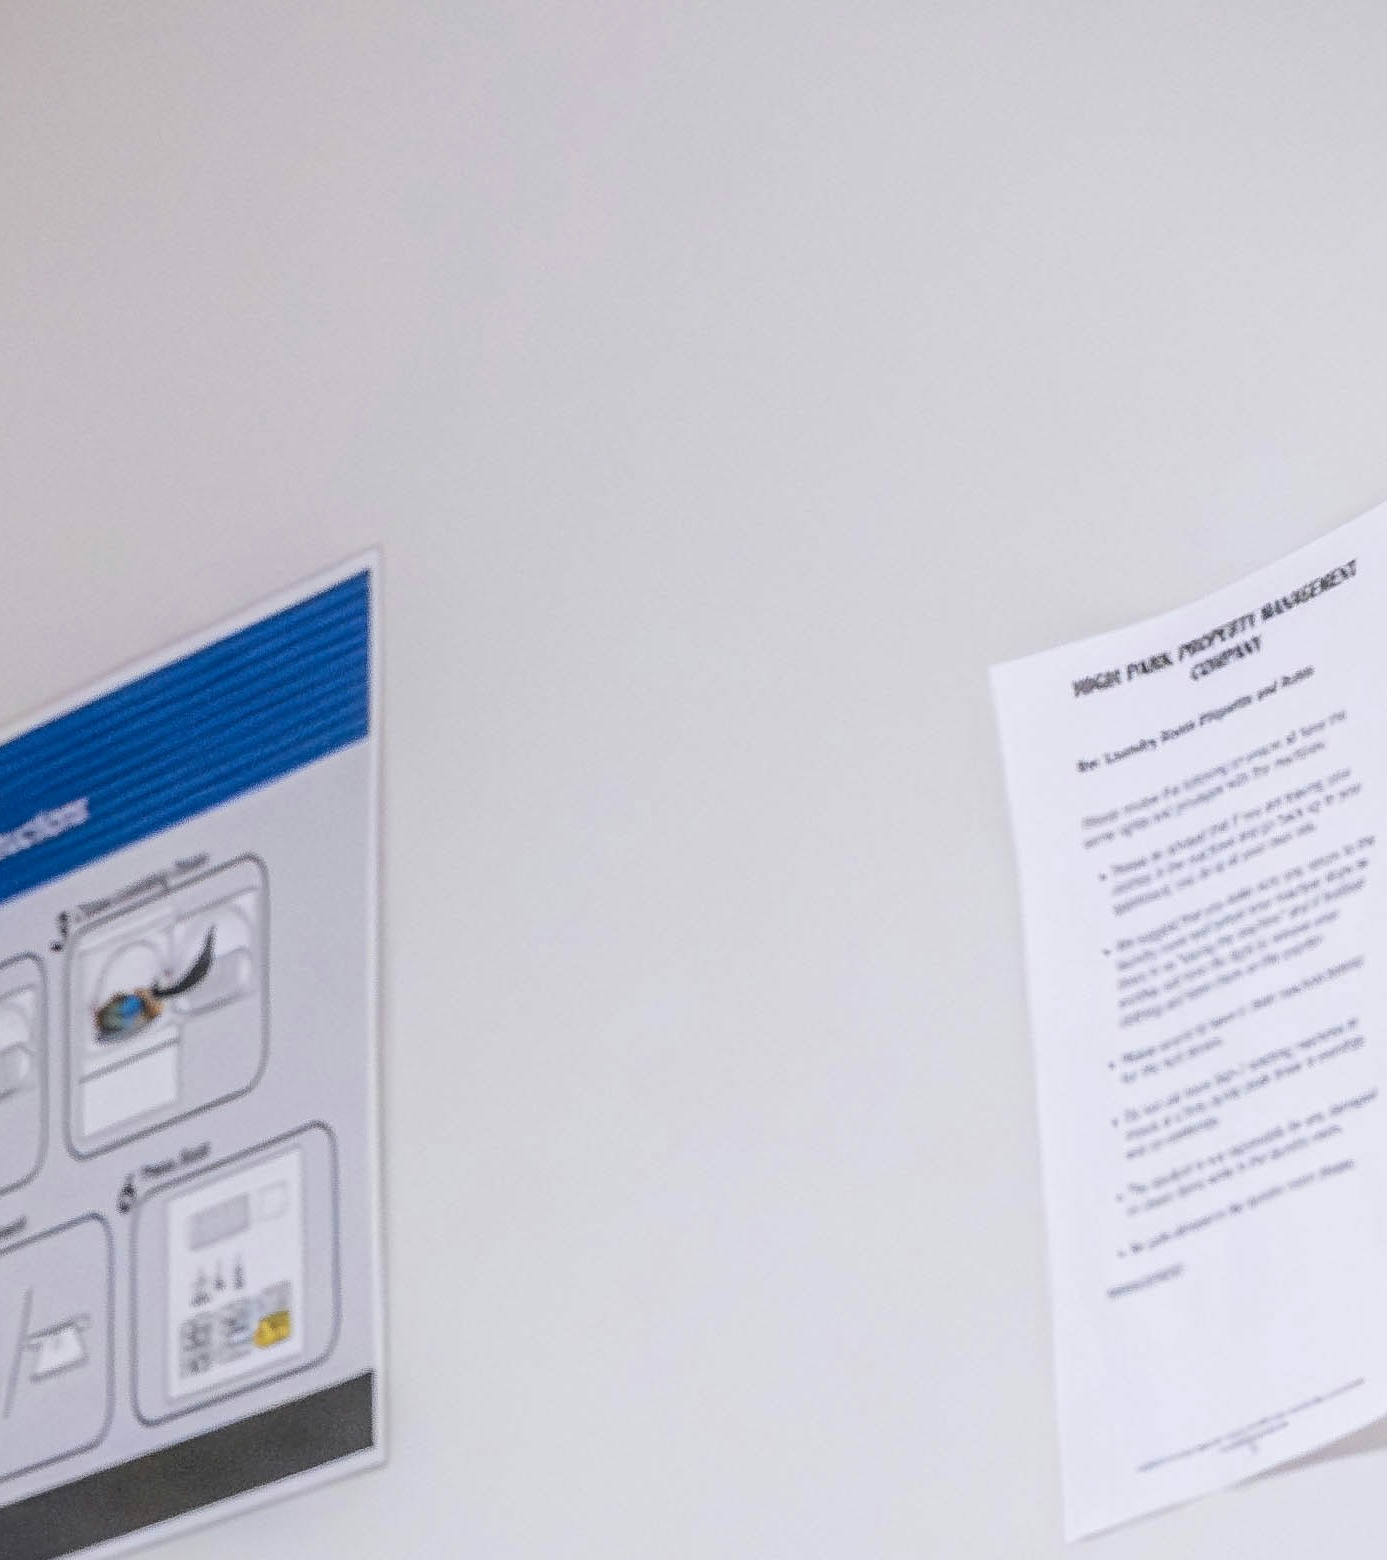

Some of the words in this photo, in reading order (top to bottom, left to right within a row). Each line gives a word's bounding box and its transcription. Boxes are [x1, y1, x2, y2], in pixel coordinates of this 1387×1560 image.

[1126, 652, 1173, 682] PARK
[1177, 611, 1256, 662] PROPERTY
[1260, 558, 1357, 621] MANAGEMENT
[1189, 634, 1261, 682] COMPANY
